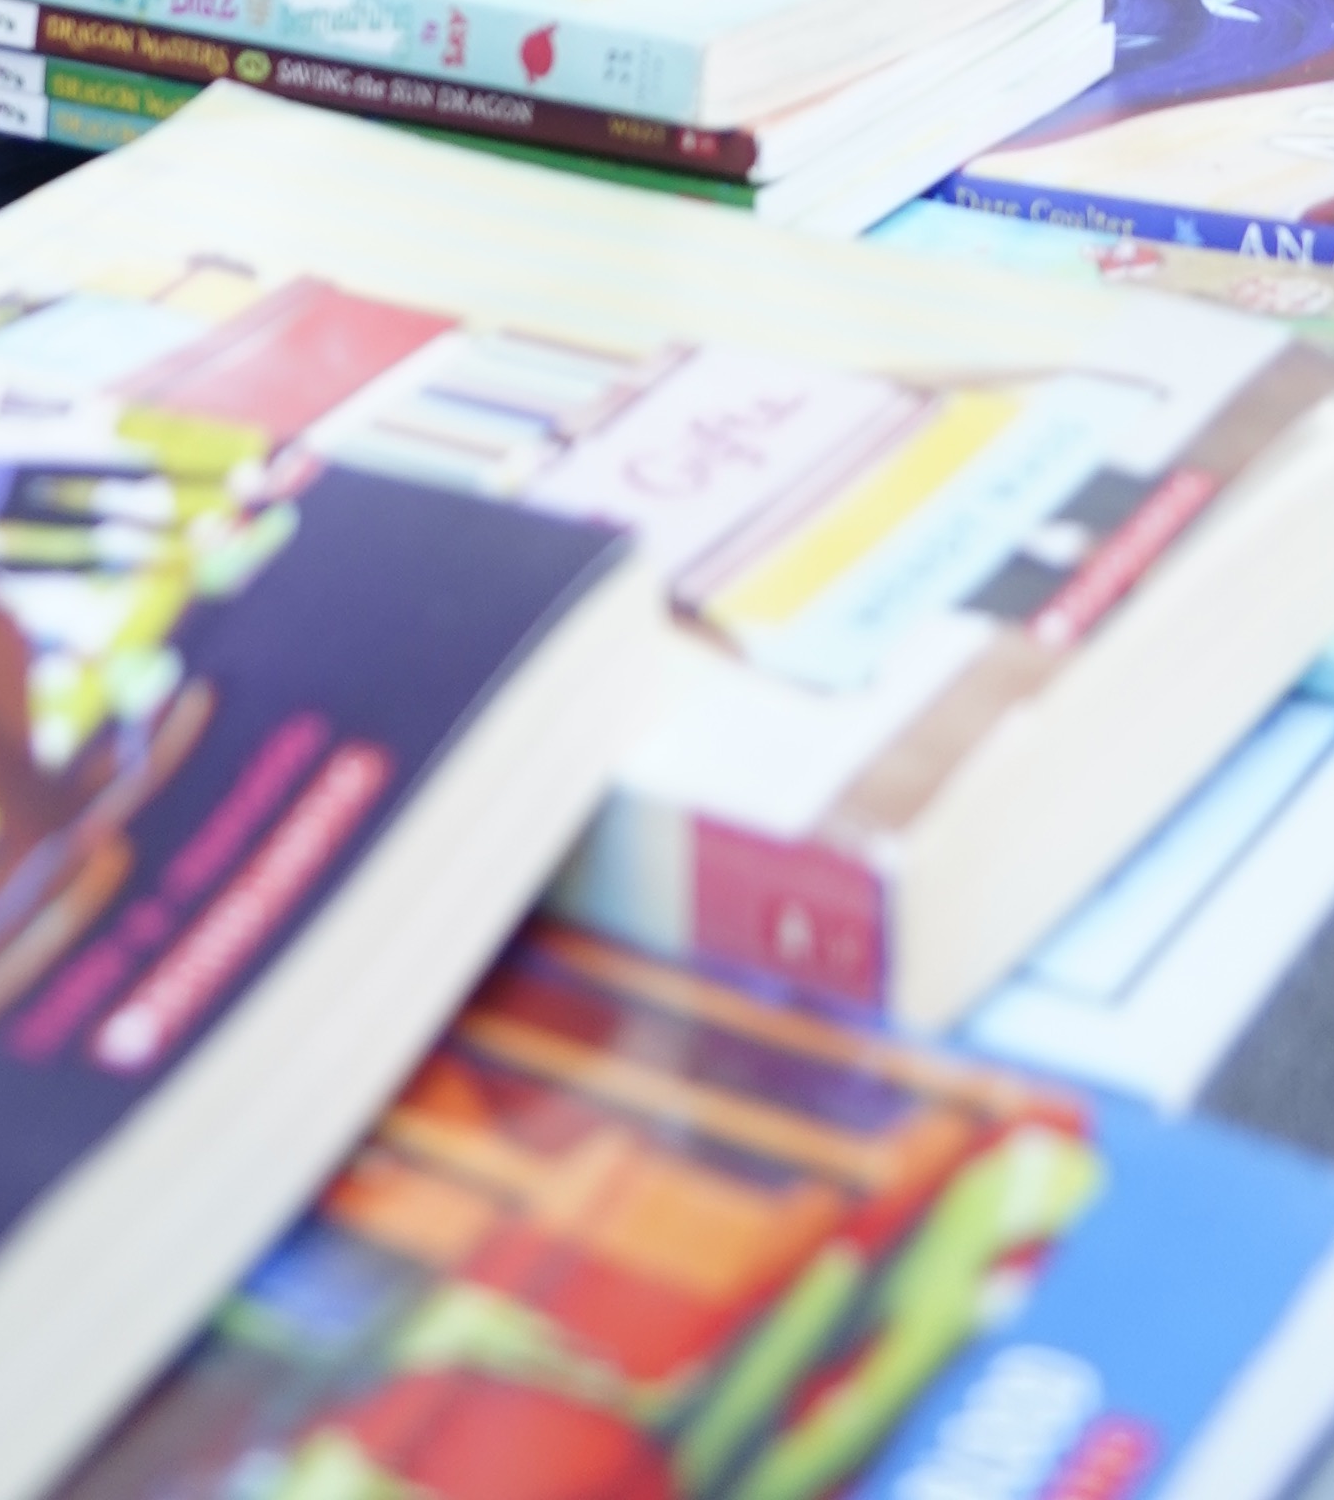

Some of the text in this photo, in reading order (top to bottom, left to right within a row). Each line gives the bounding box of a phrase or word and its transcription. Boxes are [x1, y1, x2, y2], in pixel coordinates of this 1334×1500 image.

[45, 13, 134, 56] DRAGON
[276, 58, 352, 98] SAVING
[354, 69, 387, 100] the
[388, 77, 436, 109] SUN
[438, 86, 533, 127] DRAGON
[1236, 220, 1318, 267] AN
